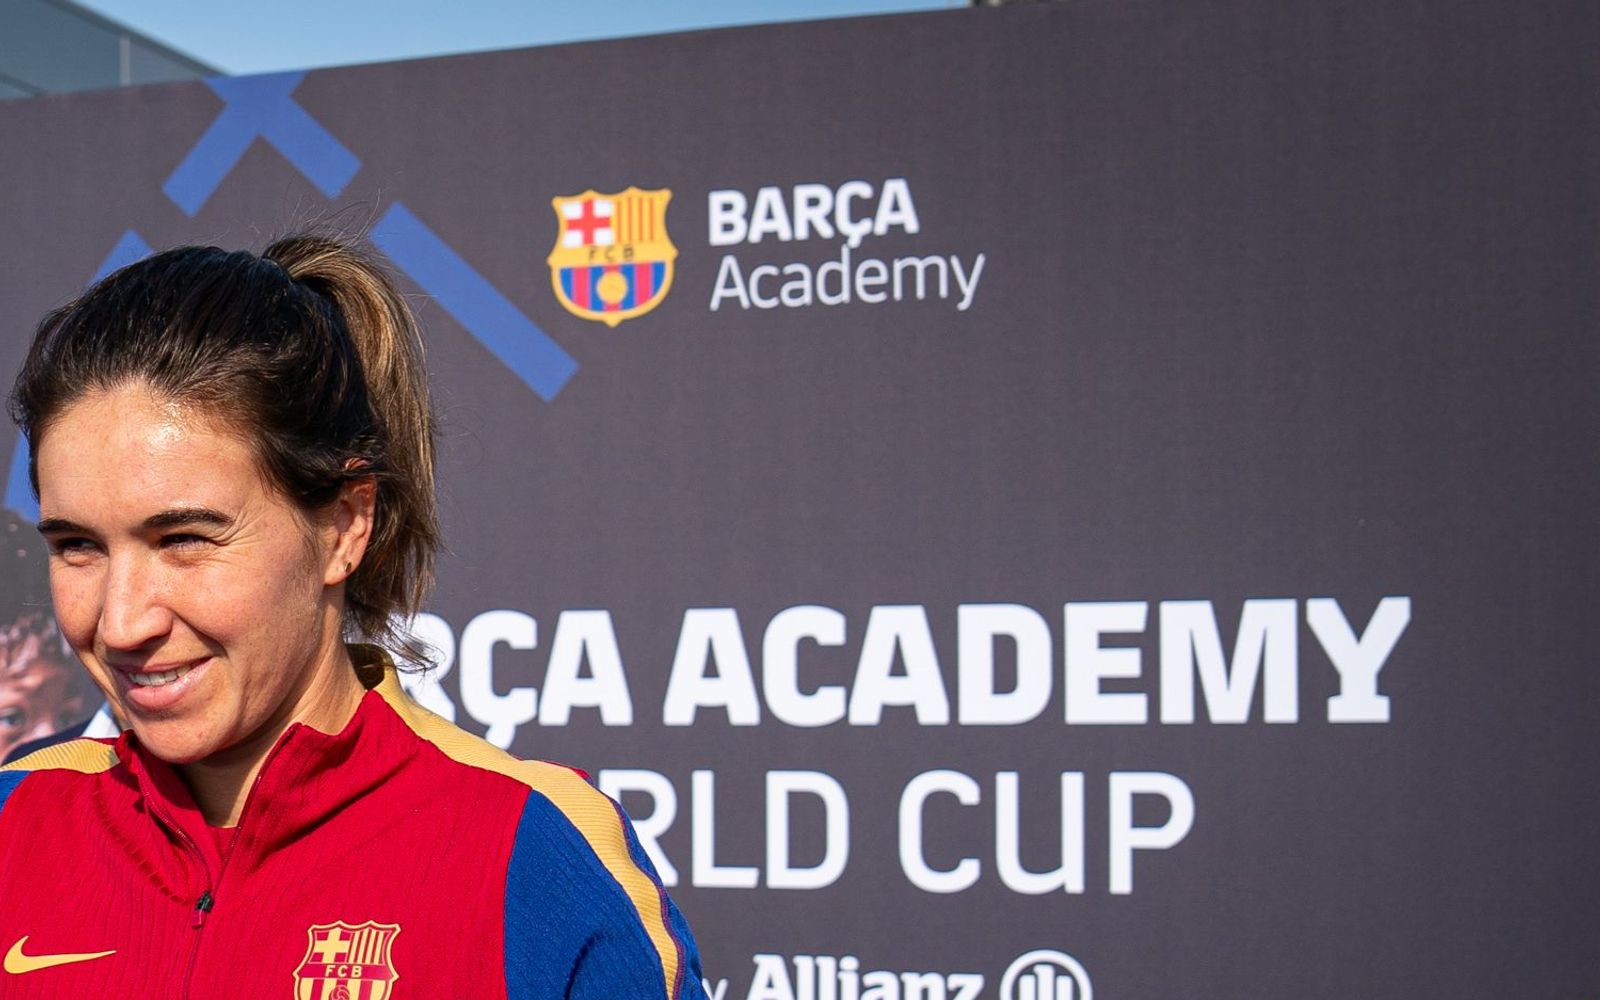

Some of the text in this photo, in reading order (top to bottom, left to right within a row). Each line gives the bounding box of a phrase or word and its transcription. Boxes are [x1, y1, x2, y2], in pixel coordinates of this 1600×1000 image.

[708, 178, 920, 248] BARÇA
[709, 245, 986, 312] Academy
[386, 596, 1412, 750] RÇA ACADEMY
[598, 768, 1196, 895] RLD CUP
[324, 963, 363, 979] FCB
